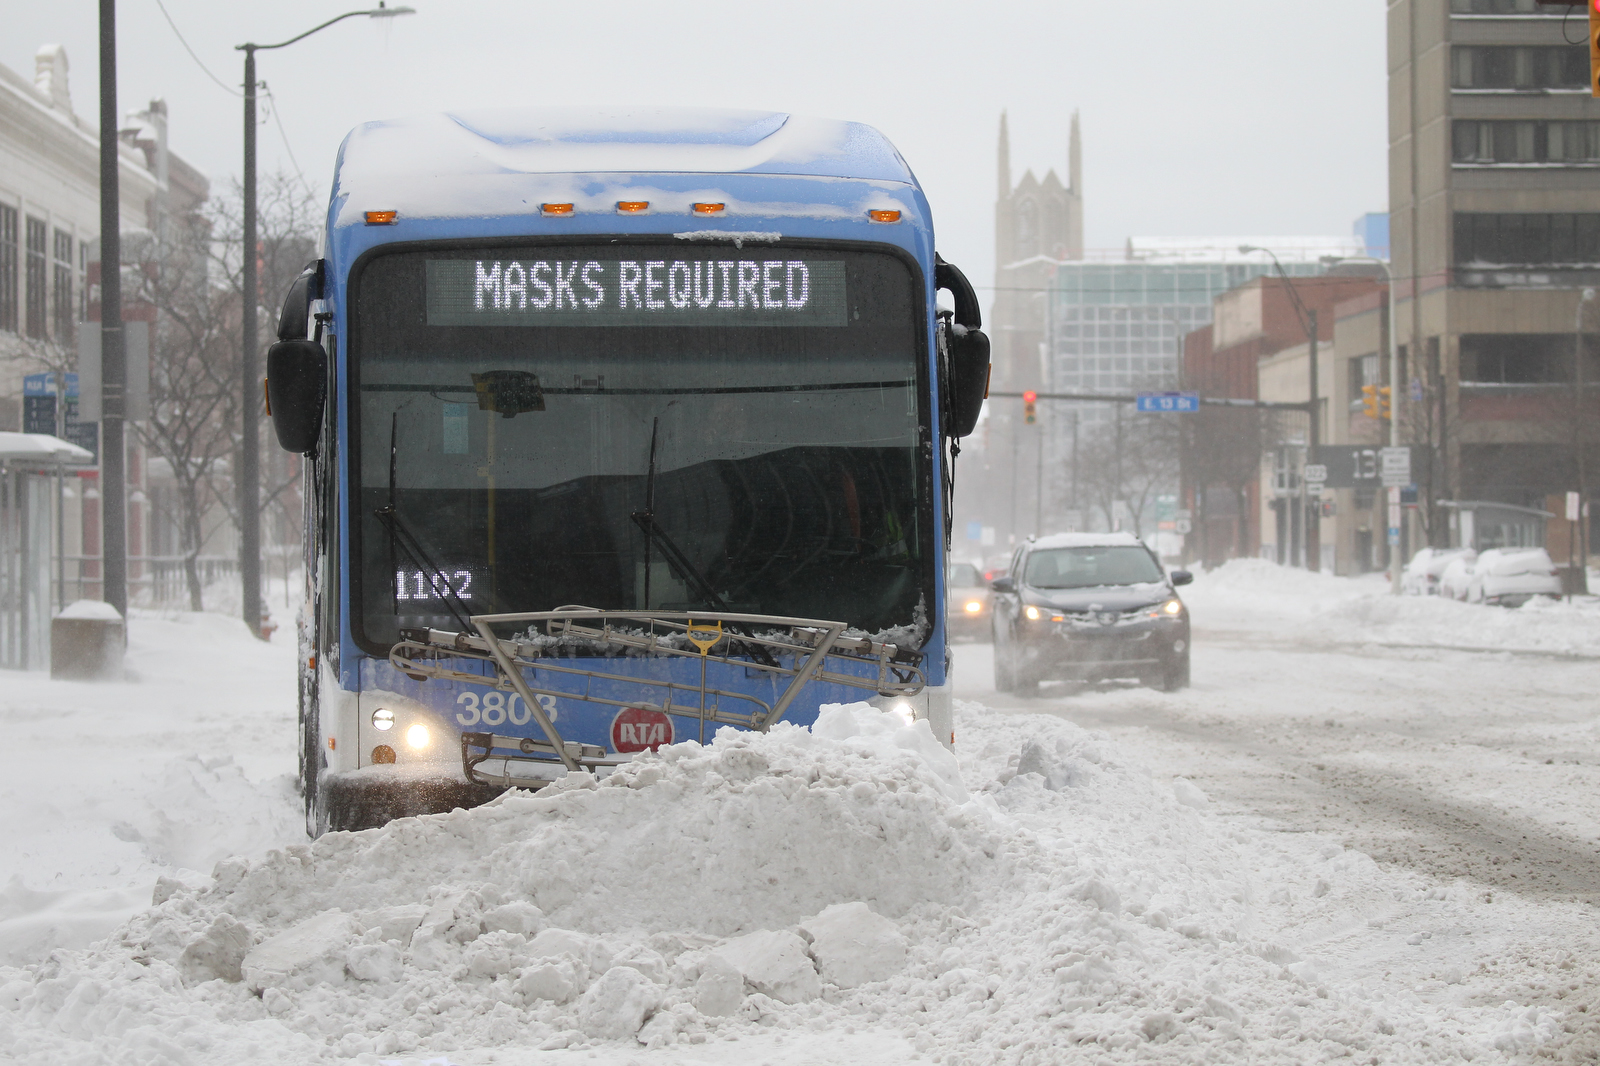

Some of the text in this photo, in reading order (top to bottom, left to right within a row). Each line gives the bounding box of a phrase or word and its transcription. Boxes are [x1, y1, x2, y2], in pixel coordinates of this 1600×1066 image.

[474, 260, 811, 310] MASKS REQUIRED
[1160, 398, 1173, 409] 13
[1352, 450, 1383, 479] 13
[396, 571, 472, 599] 1102
[456, 691, 559, 726] 3803
[620, 723, 666, 745] RTA
